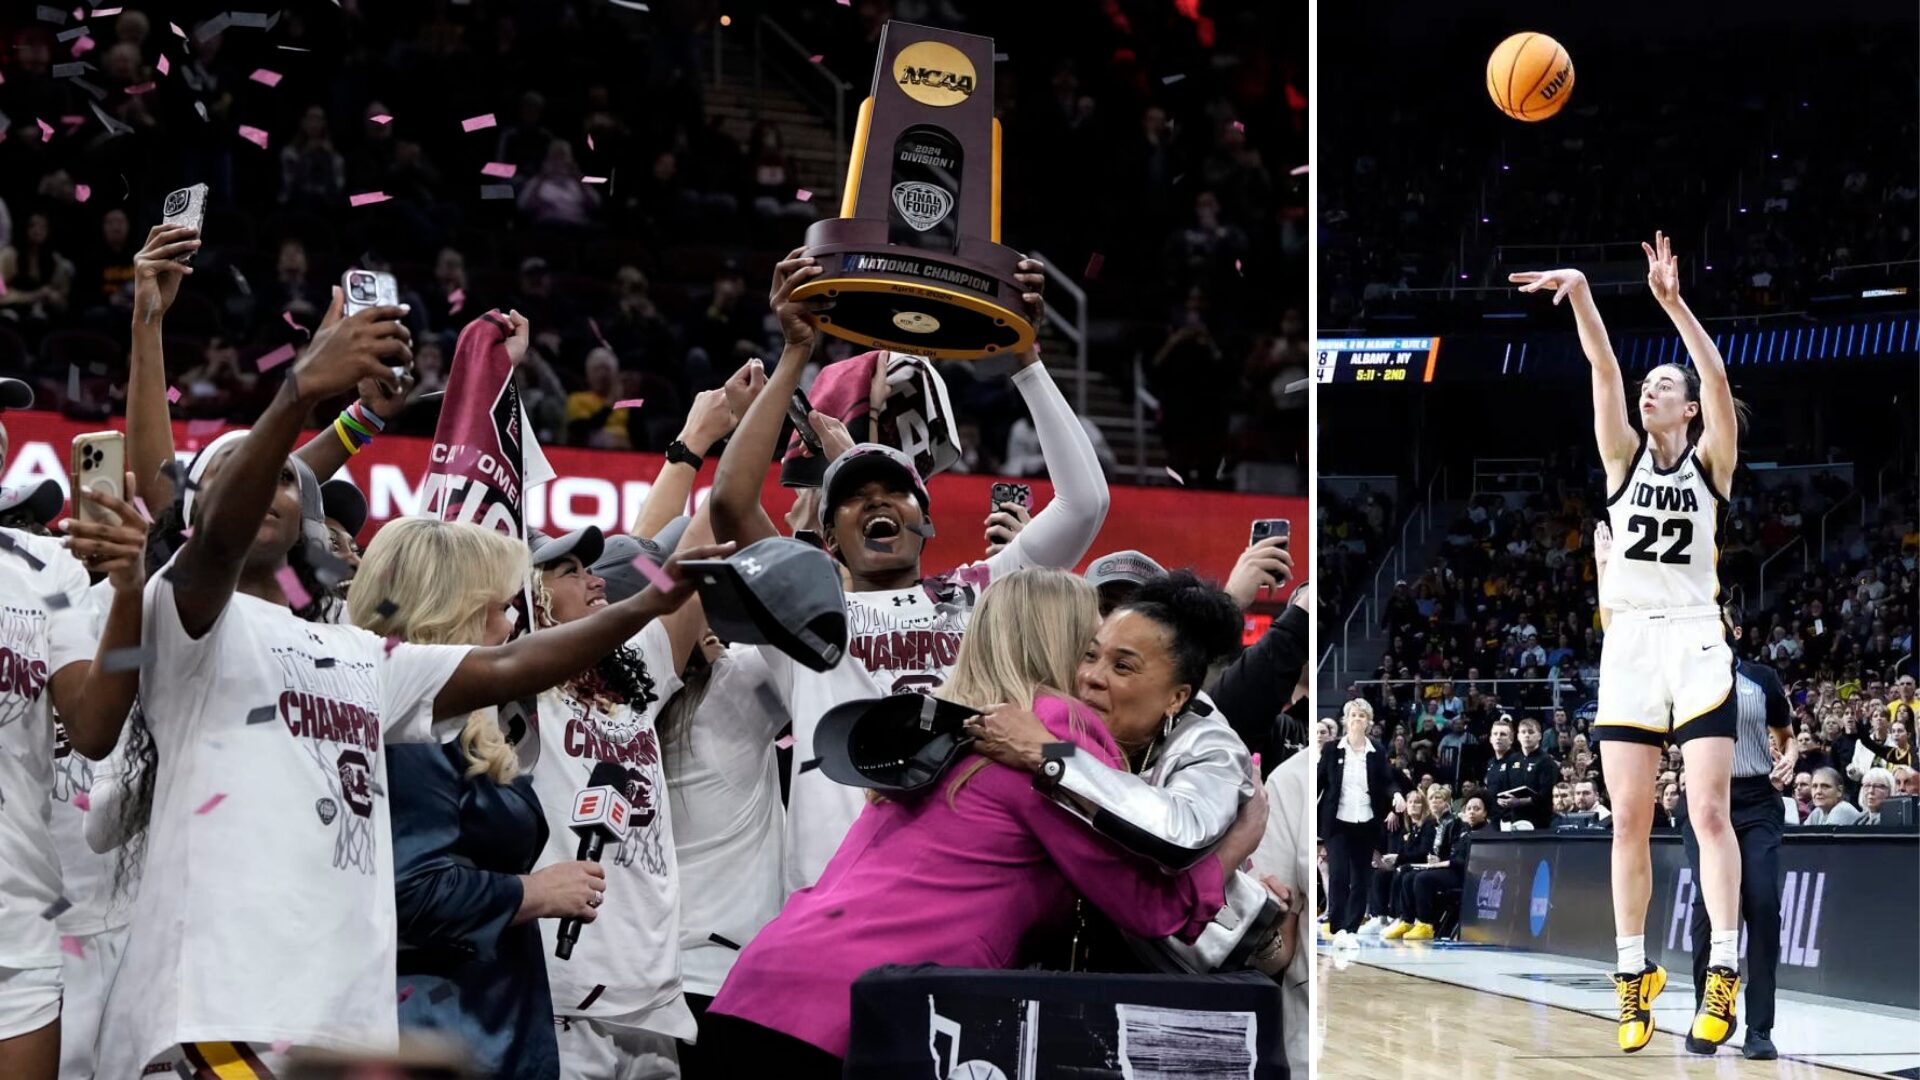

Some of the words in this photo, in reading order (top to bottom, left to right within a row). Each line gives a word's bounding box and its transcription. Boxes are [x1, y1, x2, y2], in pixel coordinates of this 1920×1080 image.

[899, 65, 973, 96] NCAA
[915, 145, 942, 156] 2024
[900, 151, 948, 168] DIVISION
[906, 191, 940, 205] FINAL
[906, 201, 938, 215] FOUR
[858, 257, 920, 275] NATIONAL
[923, 265, 990, 293] CHAMPION
[1396, 353, 1412, 364] NY
[1356, 369, 1375, 381] 5:11
[1384, 369, 1406, 381] 2ND
[1630, 482, 1698, 512] IOWA
[1625, 514, 1693, 564] 22
